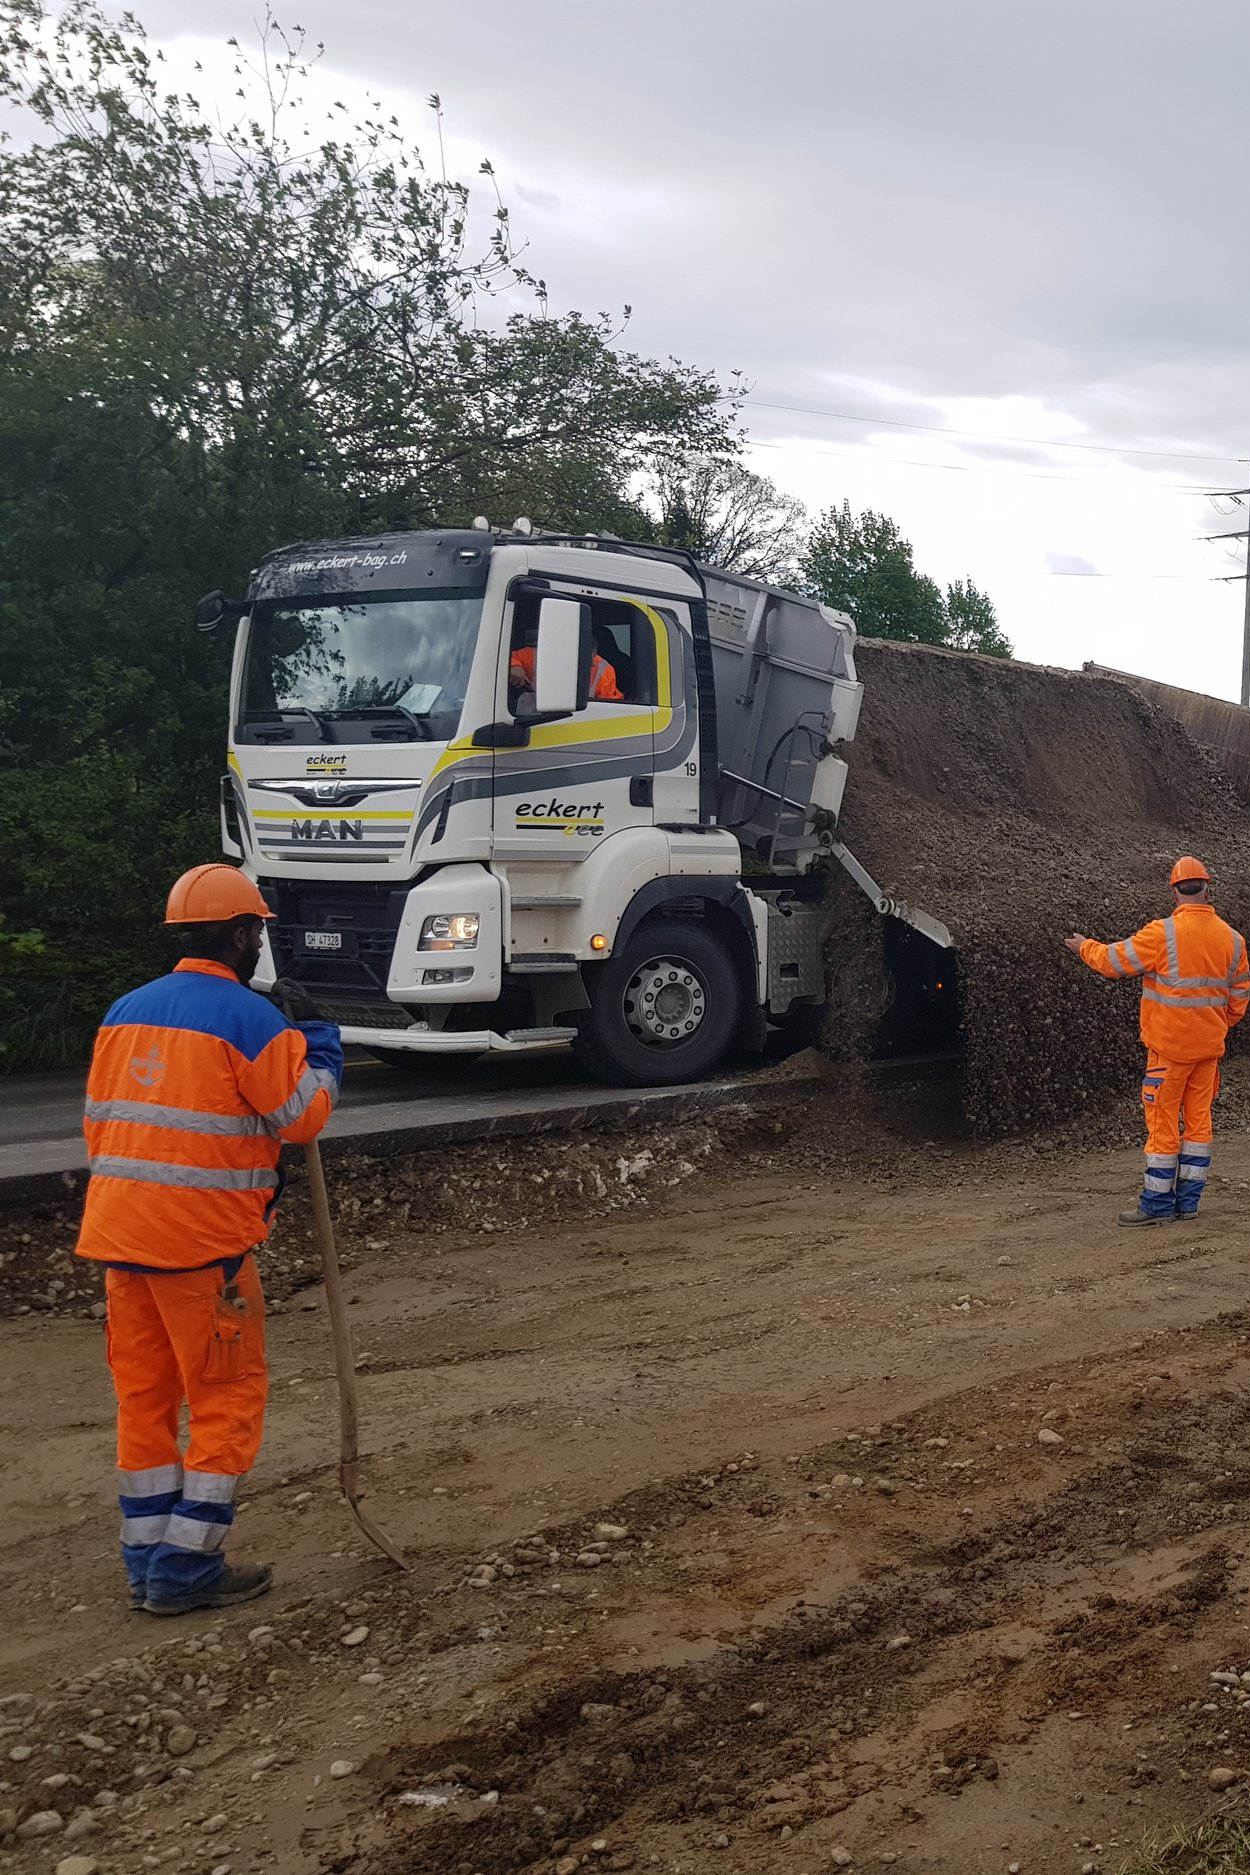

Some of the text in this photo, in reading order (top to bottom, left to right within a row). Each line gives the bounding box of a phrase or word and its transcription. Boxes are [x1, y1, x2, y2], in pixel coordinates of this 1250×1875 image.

[288, 550, 408, 573] www.eckert-bag.ch
[306, 753, 347, 765] eckert
[683, 762, 697, 777] 19
[515, 798, 605, 819] eckert
[291, 818, 364, 841] MAN
